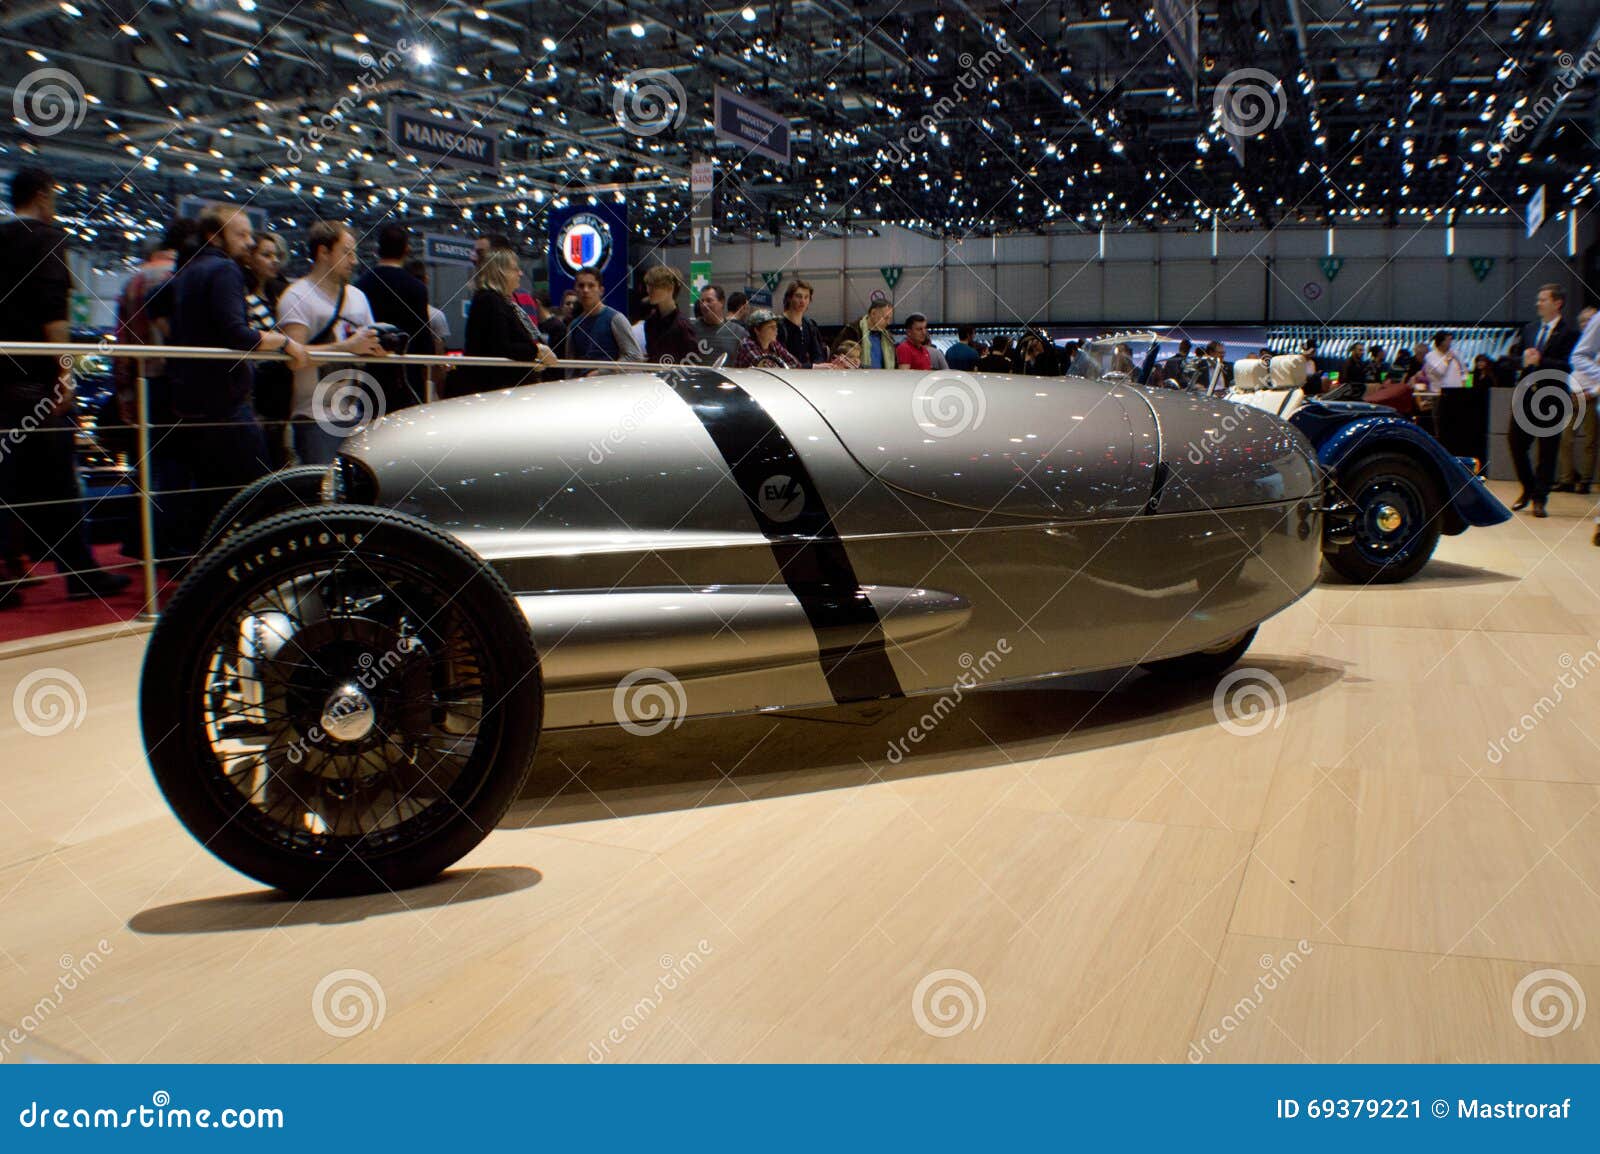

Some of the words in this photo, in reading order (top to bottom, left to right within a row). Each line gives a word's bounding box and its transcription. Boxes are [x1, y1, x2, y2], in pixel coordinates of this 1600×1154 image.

[404, 121, 488, 158] MANSORY
[434, 242, 474, 257] STARTEC
[226, 532, 364, 582] Firestone
